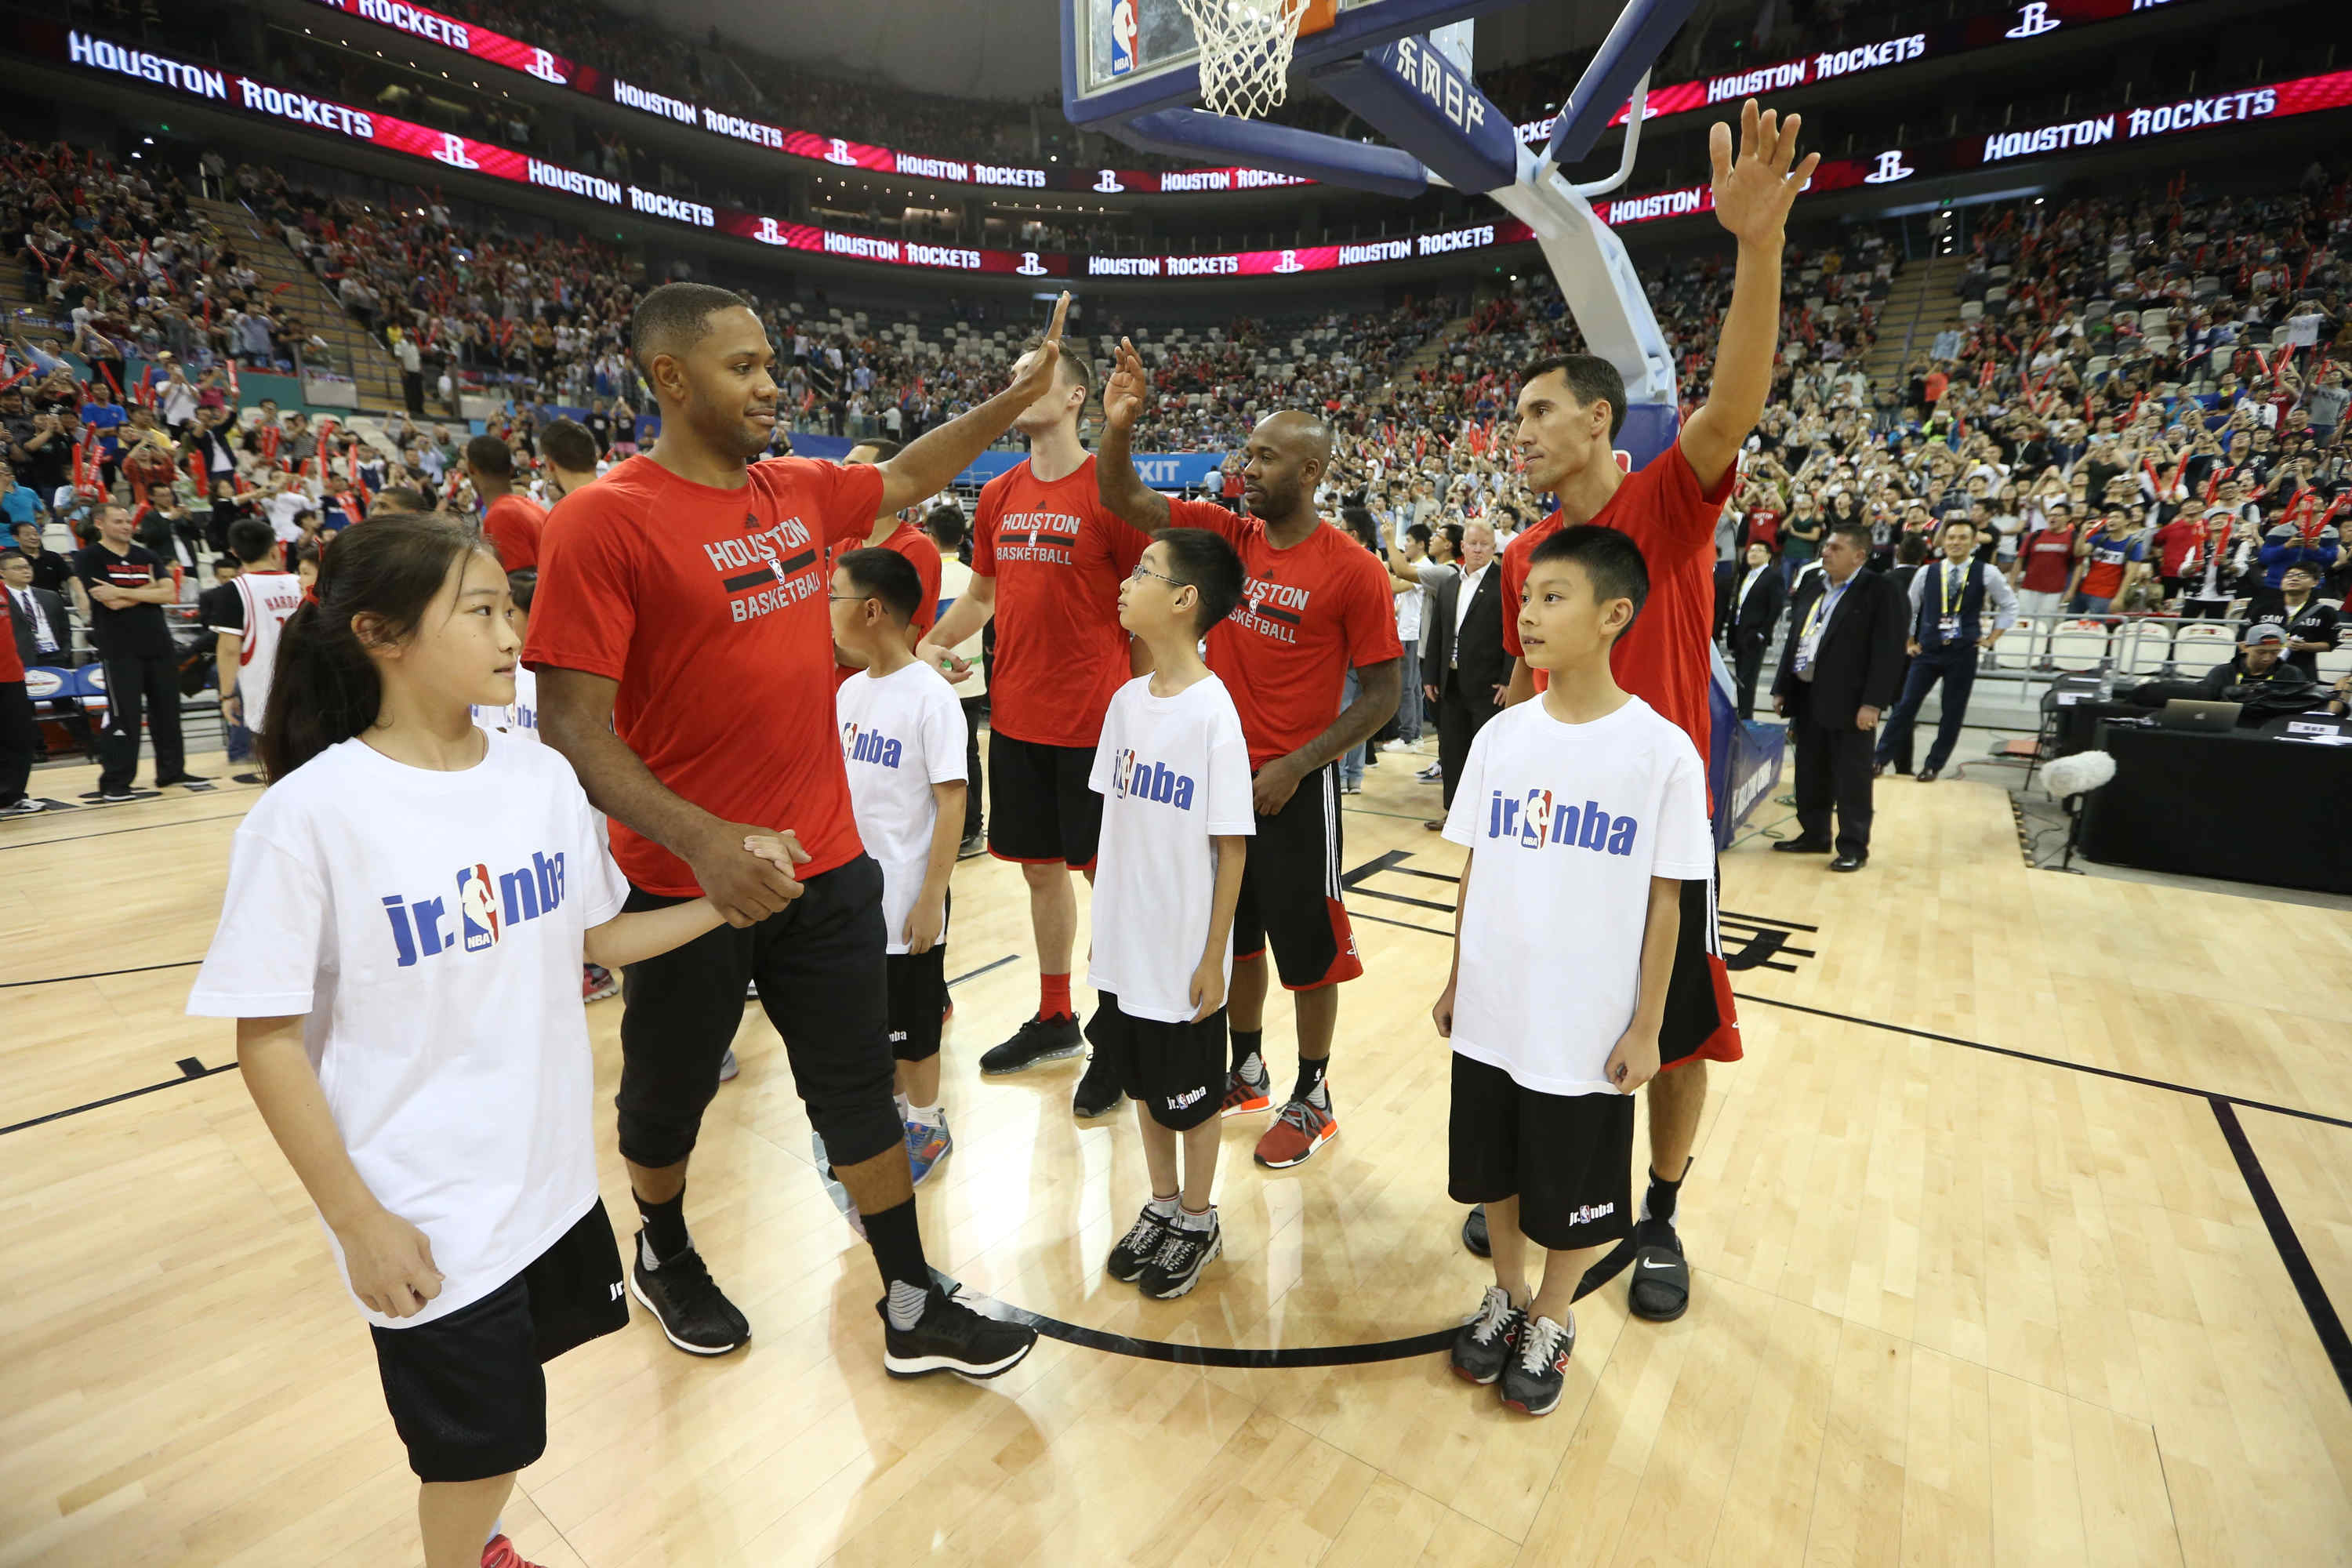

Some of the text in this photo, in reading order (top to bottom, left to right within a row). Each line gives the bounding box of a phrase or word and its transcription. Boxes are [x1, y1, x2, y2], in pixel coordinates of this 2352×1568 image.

[358, 0, 469, 49] ROCKETS
[1114, 56, 1130, 71] NBA
[1708, 34, 1926, 106] HOUSTON ROCKETS
[69, 31, 373, 138] HOUSTON ROCKETS
[1396, 35, 1485, 134] 东风日产
[613, 78, 783, 148] HOUSTON ROCKETS
[1984, 89, 2276, 162] HOUSTON ROCKETS
[896, 153, 1046, 188] HOUSTON ROCKETS
[1160, 170, 1230, 191] HOUSTON
[528, 158, 714, 227] HOUSTON ROCKETS
[1608, 183, 1700, 225] HOUSTON
[824, 230, 981, 269] HOUSTON ROCKETS
[1088, 256, 1239, 276] HOUSTON ROCKETS
[1338, 225, 1494, 266] HOUSTON ROCKETS
[1133, 460, 1180, 482] XIT
[703, 516, 811, 572] HOUSTON
[1001, 513, 1081, 535] HOUSTON
[996, 546, 1073, 565] BASKETBALL
[1242, 576, 1310, 612] USTON
[1229, 608, 1296, 644] SKETBALL
[851, 728, 902, 769] nba
[1130, 760, 1195, 811] nba
[1489, 789, 1638, 856] jr. nba
[381, 895, 455, 967] jr.
[467, 933, 490, 949] NBA
[1590, 1202, 1614, 1219] nba
